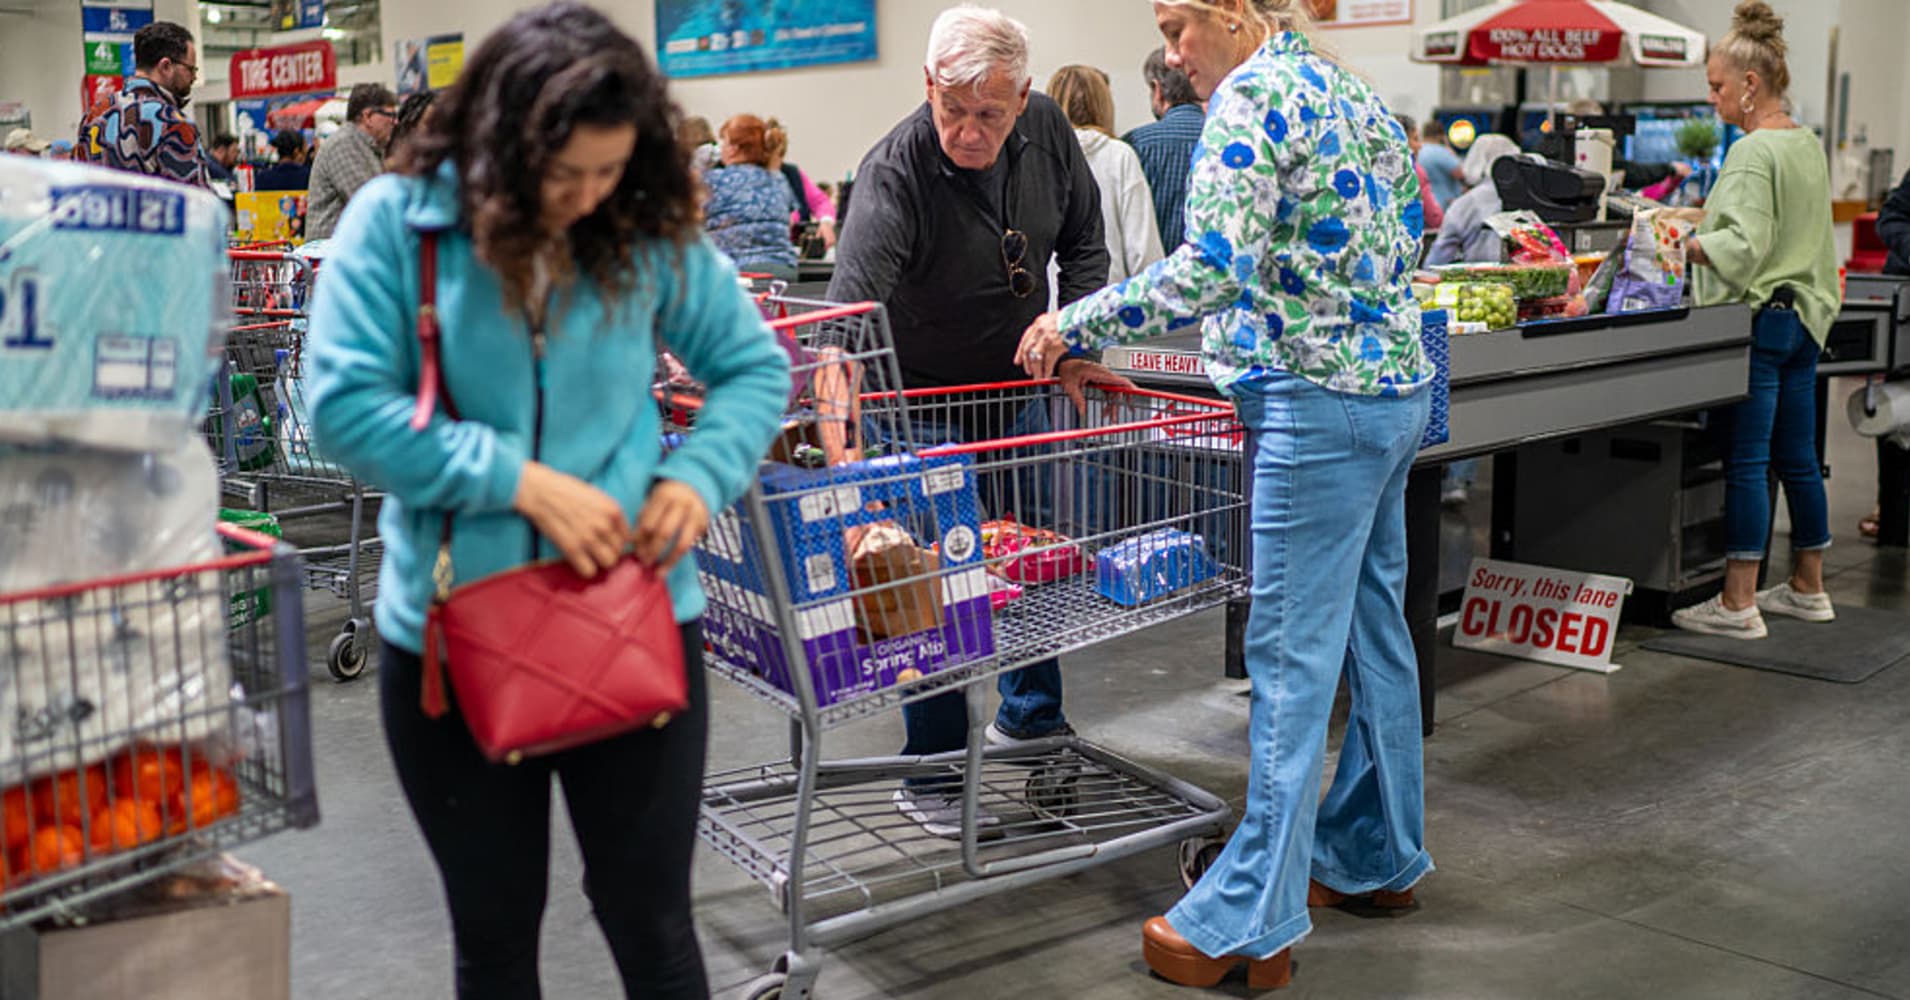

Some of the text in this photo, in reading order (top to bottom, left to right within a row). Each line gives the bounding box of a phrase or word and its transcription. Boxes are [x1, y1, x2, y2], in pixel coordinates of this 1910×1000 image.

[1501, 42, 1586, 59] HOT DOGS
[1530, 28, 1560, 44] ALL
[1565, 29, 1602, 46] BEEF
[240, 50, 324, 92] TIRE CENTER
[1130, 351, 1162, 370] LEAVE
[1164, 354, 1199, 374] HEAVY
[1471, 567, 1619, 609] Sorry, this lane
[1461, 596, 1609, 657] CLOSED
